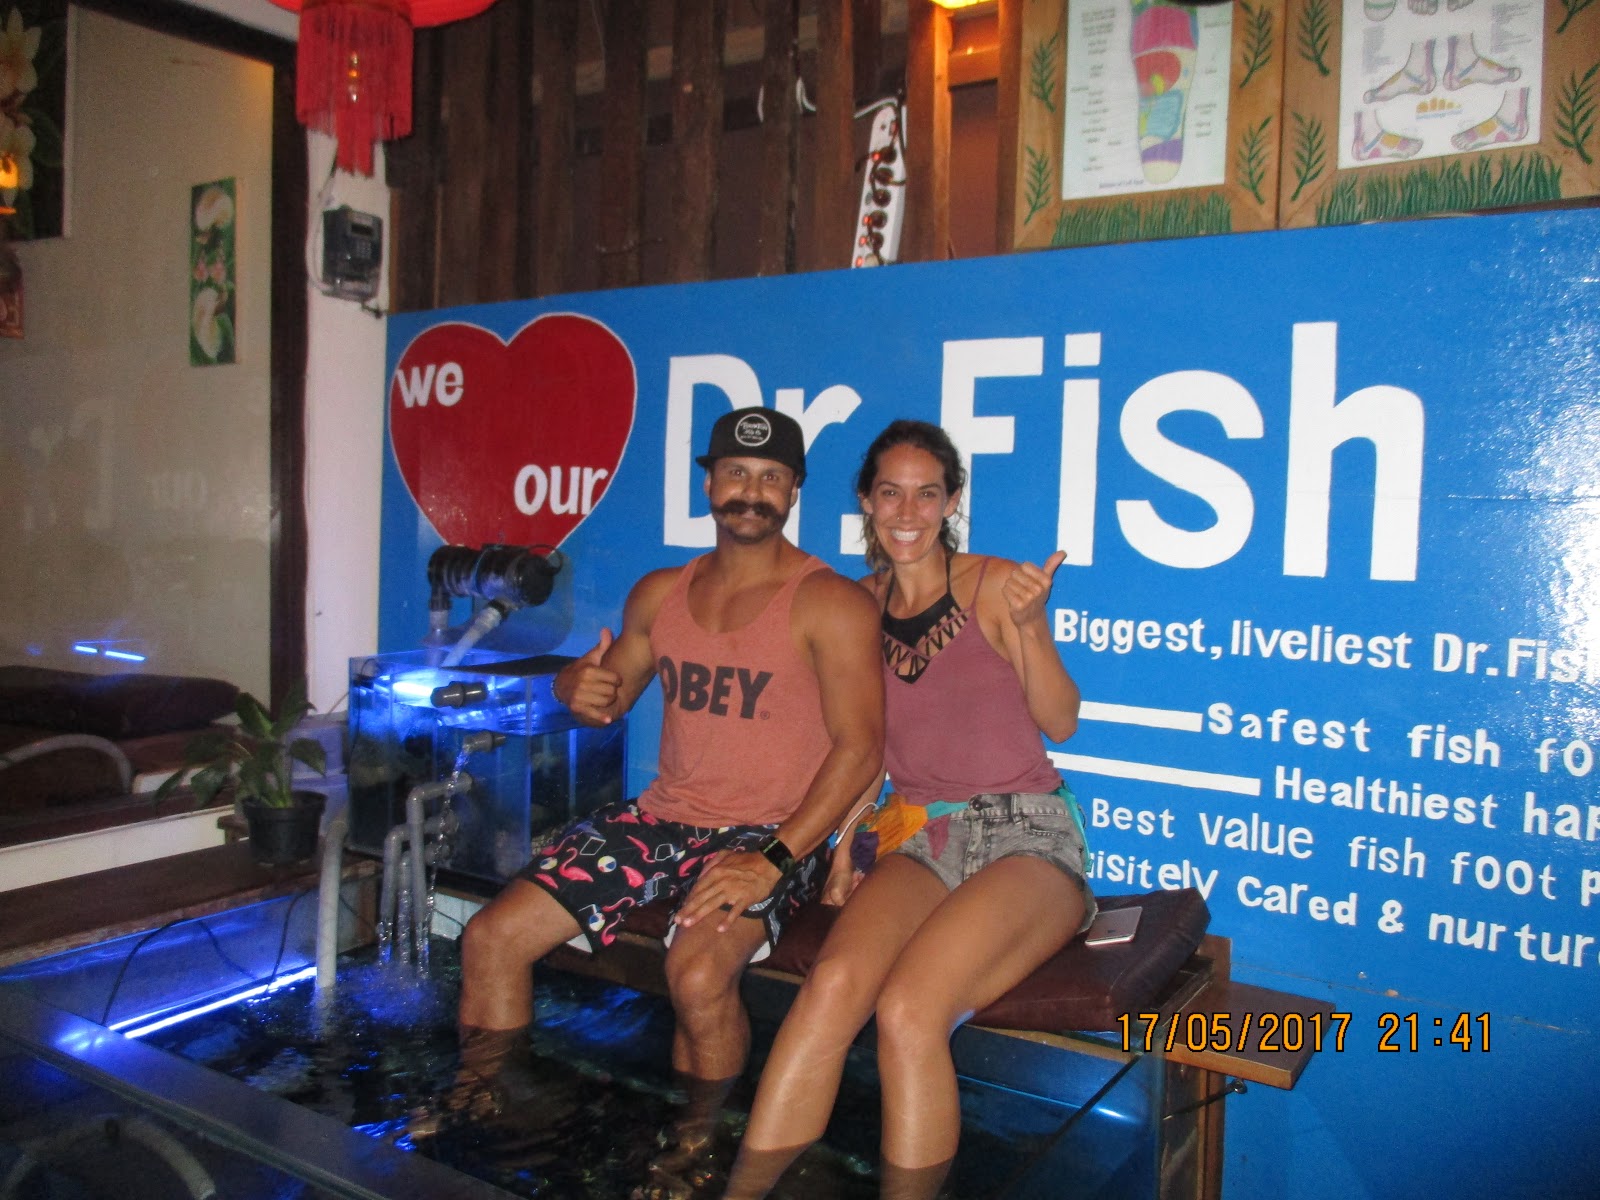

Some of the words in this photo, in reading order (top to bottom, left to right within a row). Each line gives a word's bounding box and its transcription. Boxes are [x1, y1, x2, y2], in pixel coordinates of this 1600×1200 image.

[396, 361, 464, 408] we
[514, 464, 609, 515] our
[1054, 608, 1223, 660] Biggest,
[1230, 619, 1413, 669] liveliest
[659, 655, 774, 720] OBEY
[1207, 702, 1371, 753] Safest
[1407, 724, 1501, 768] fish
[1274, 766, 1499, 829] Healthiest
[1092, 798, 1175, 839] Best
[1348, 836, 1427, 878] fish
[1086, 850, 1219, 901] isitely
[1378, 899, 1405, 934] &
